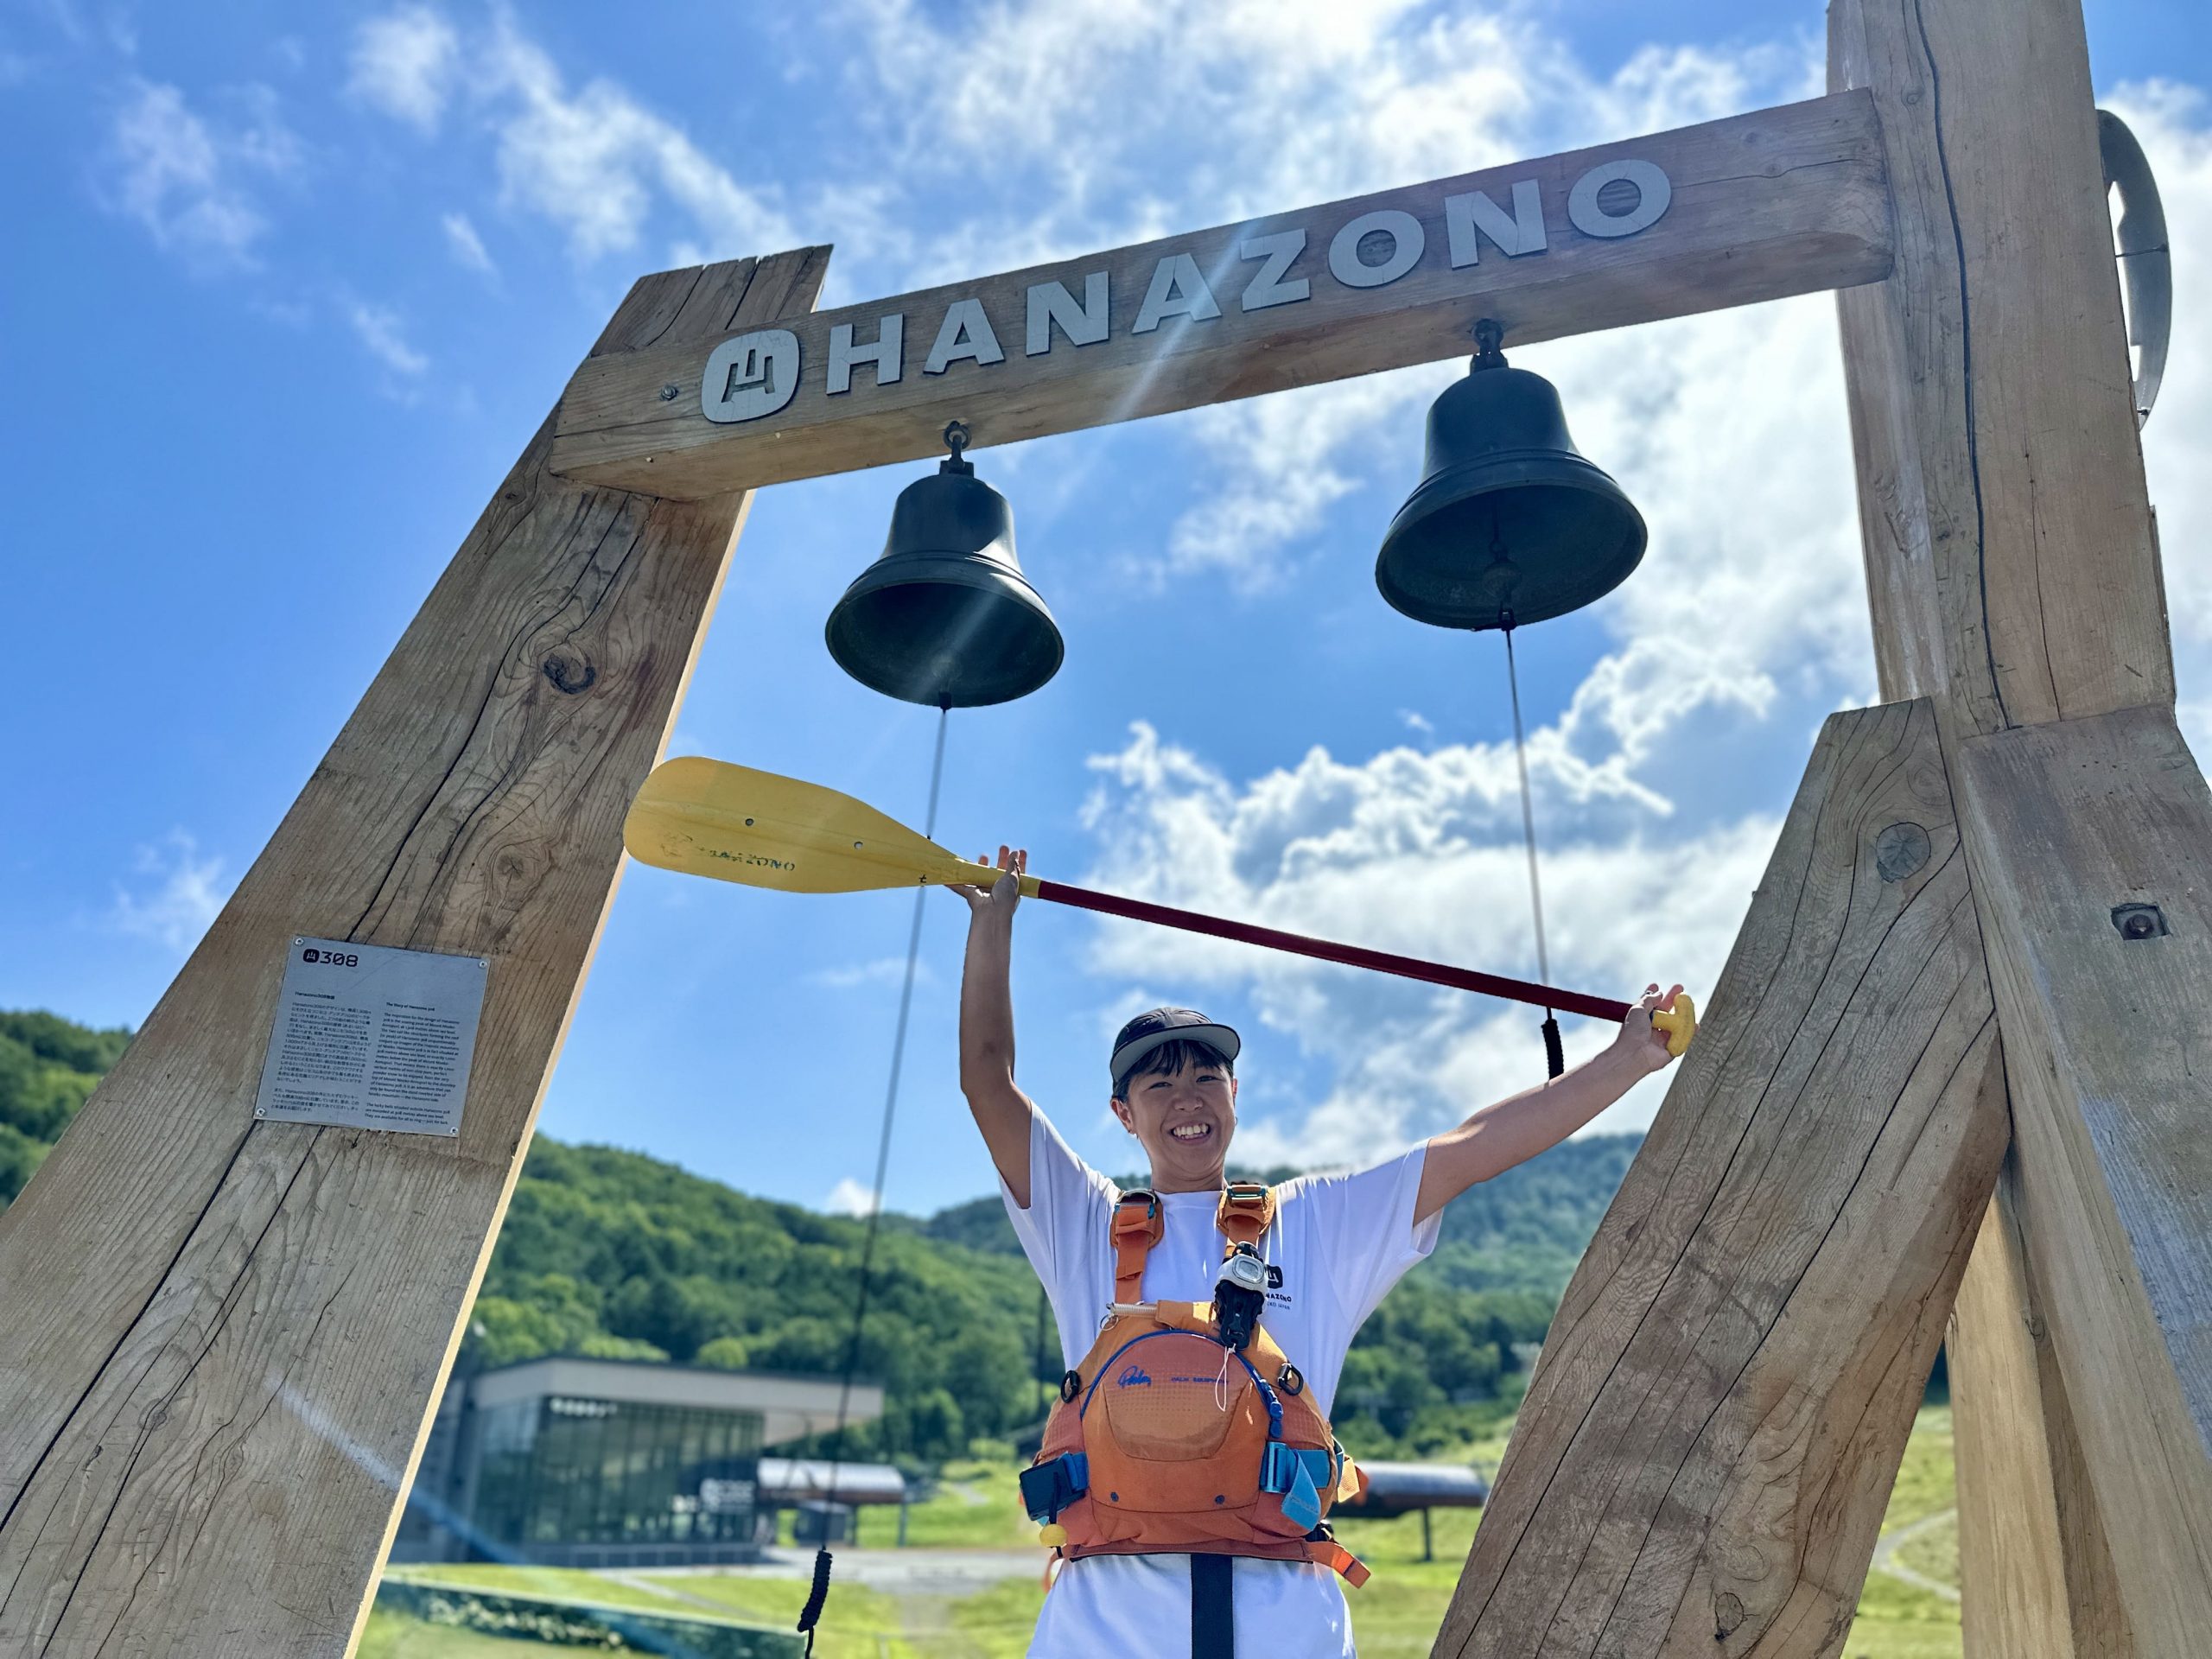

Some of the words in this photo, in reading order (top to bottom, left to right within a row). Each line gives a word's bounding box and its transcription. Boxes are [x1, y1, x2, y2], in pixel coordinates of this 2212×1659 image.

[826, 158, 1672, 397] HANAZONO
[320, 950, 359, 967] 308
[1265, 1292, 1292, 1302] NAZONO
